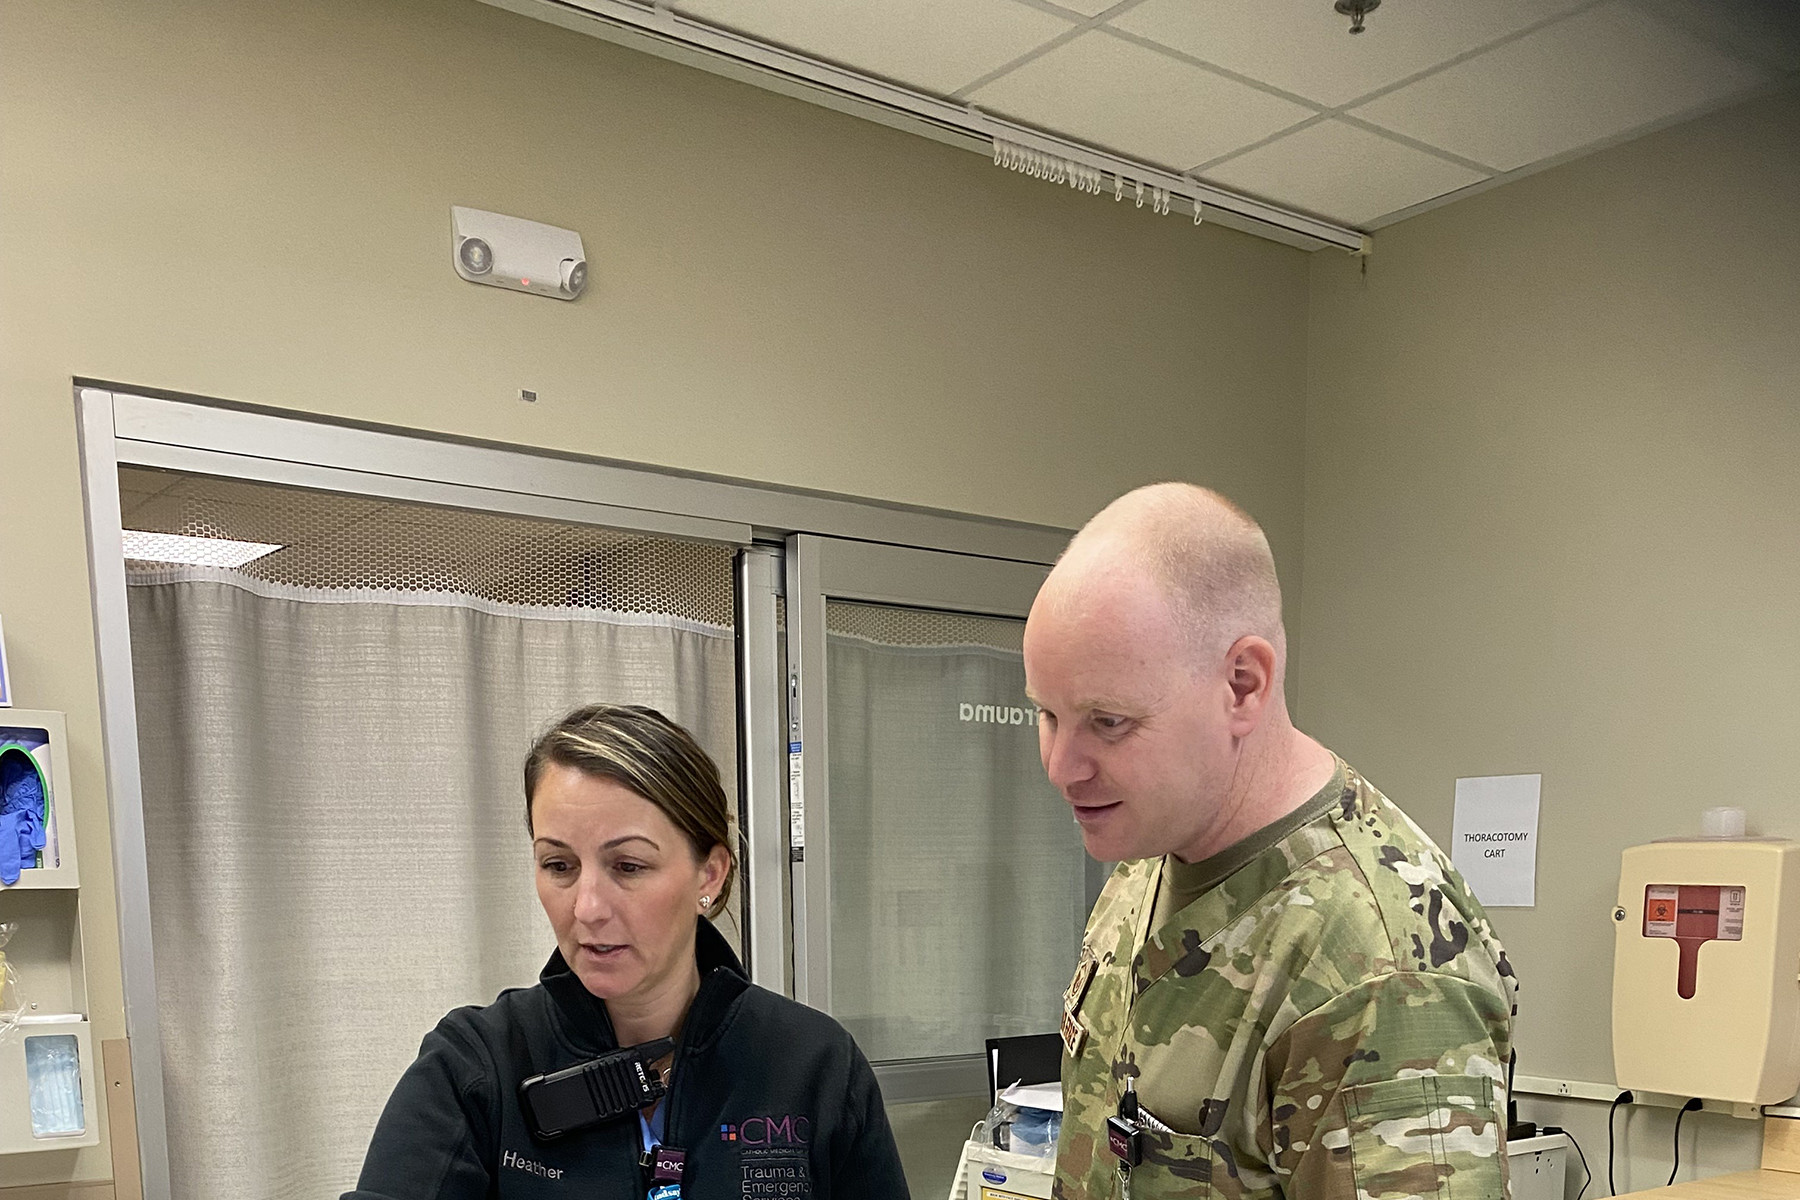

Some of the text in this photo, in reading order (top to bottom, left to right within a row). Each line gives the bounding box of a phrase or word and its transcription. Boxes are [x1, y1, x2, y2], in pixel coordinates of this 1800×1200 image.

[1464, 832, 1529, 842] THORACOTOMY
[1484, 849, 1506, 858] CART
[740, 1114, 810, 1145] CMC
[503, 1150, 564, 1180] Heather
[662, 1160, 684, 1172] CMC
[741, 1165, 806, 1179] Trauma &
